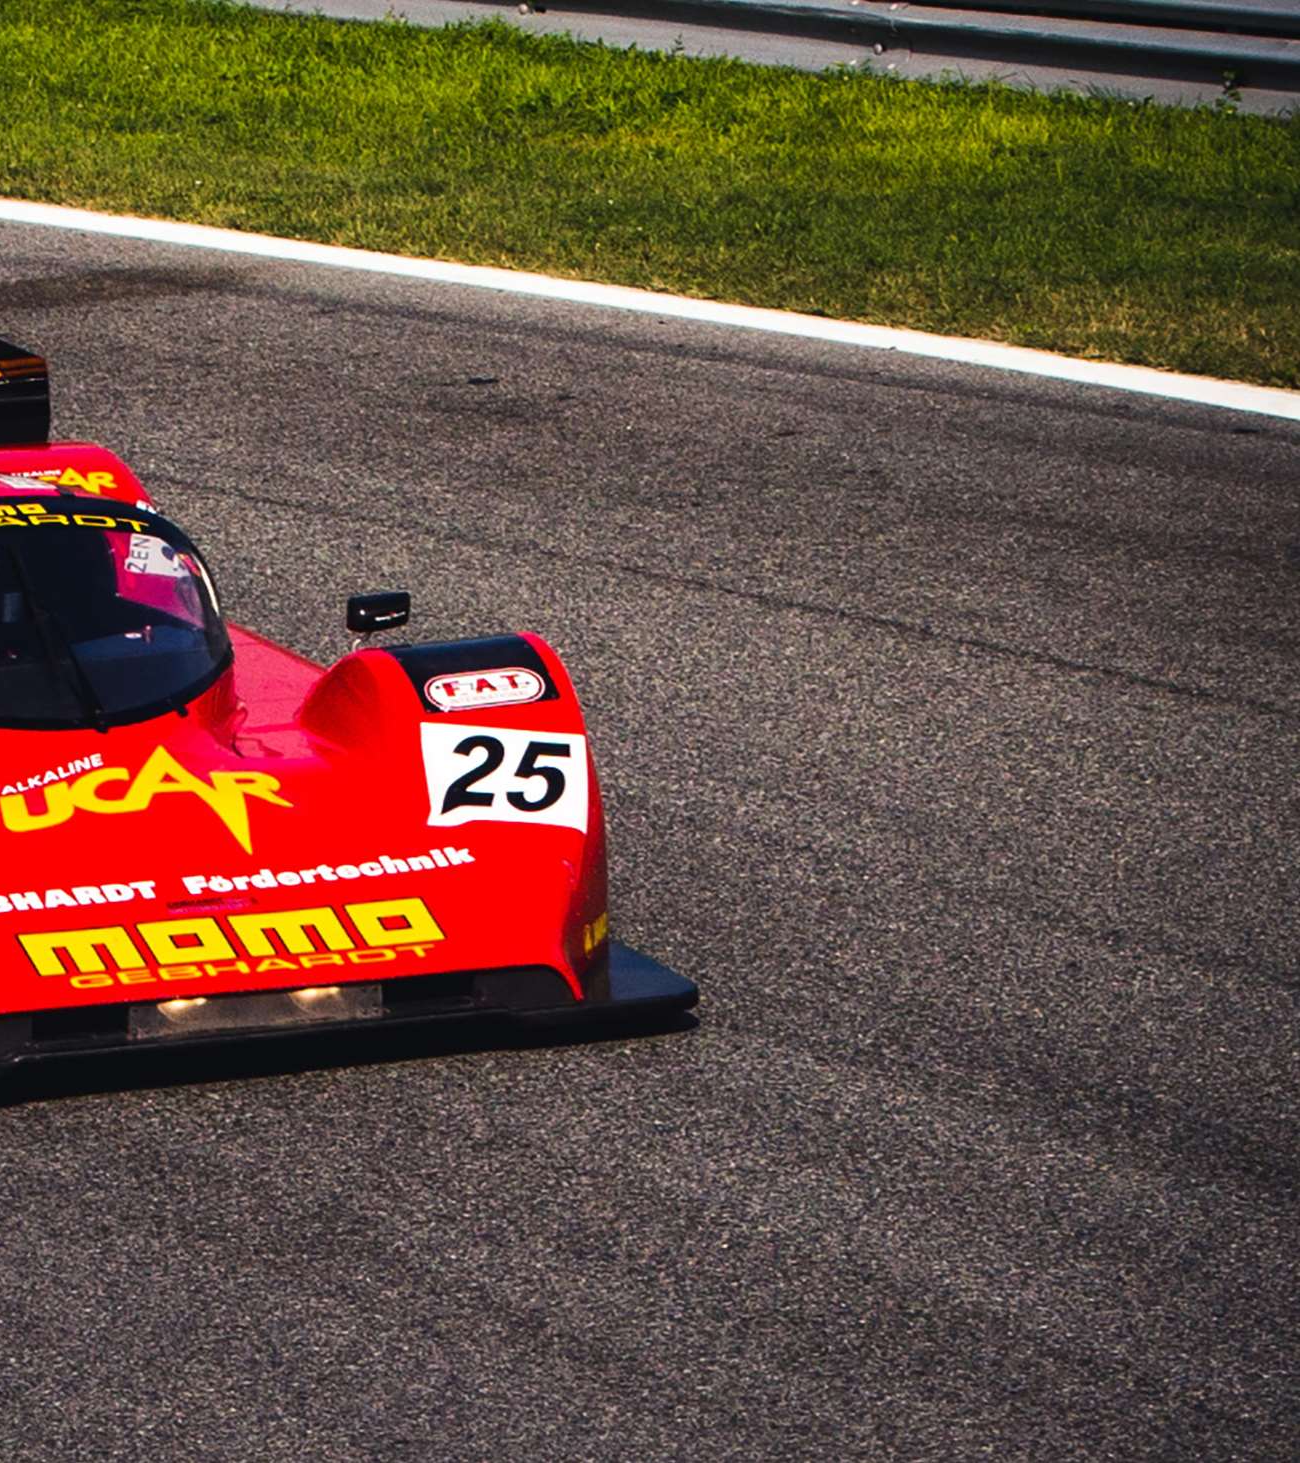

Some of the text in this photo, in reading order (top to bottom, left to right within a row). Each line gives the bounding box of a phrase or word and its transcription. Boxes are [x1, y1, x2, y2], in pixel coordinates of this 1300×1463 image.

[1, 753, 103, 796] ALKALINE
[440, 734, 570, 812] 25
[0, 745, 294, 855] UCAR
[182, 845, 475, 895] Fördertechnik
[70, 943, 435, 989] GEBHARDT
